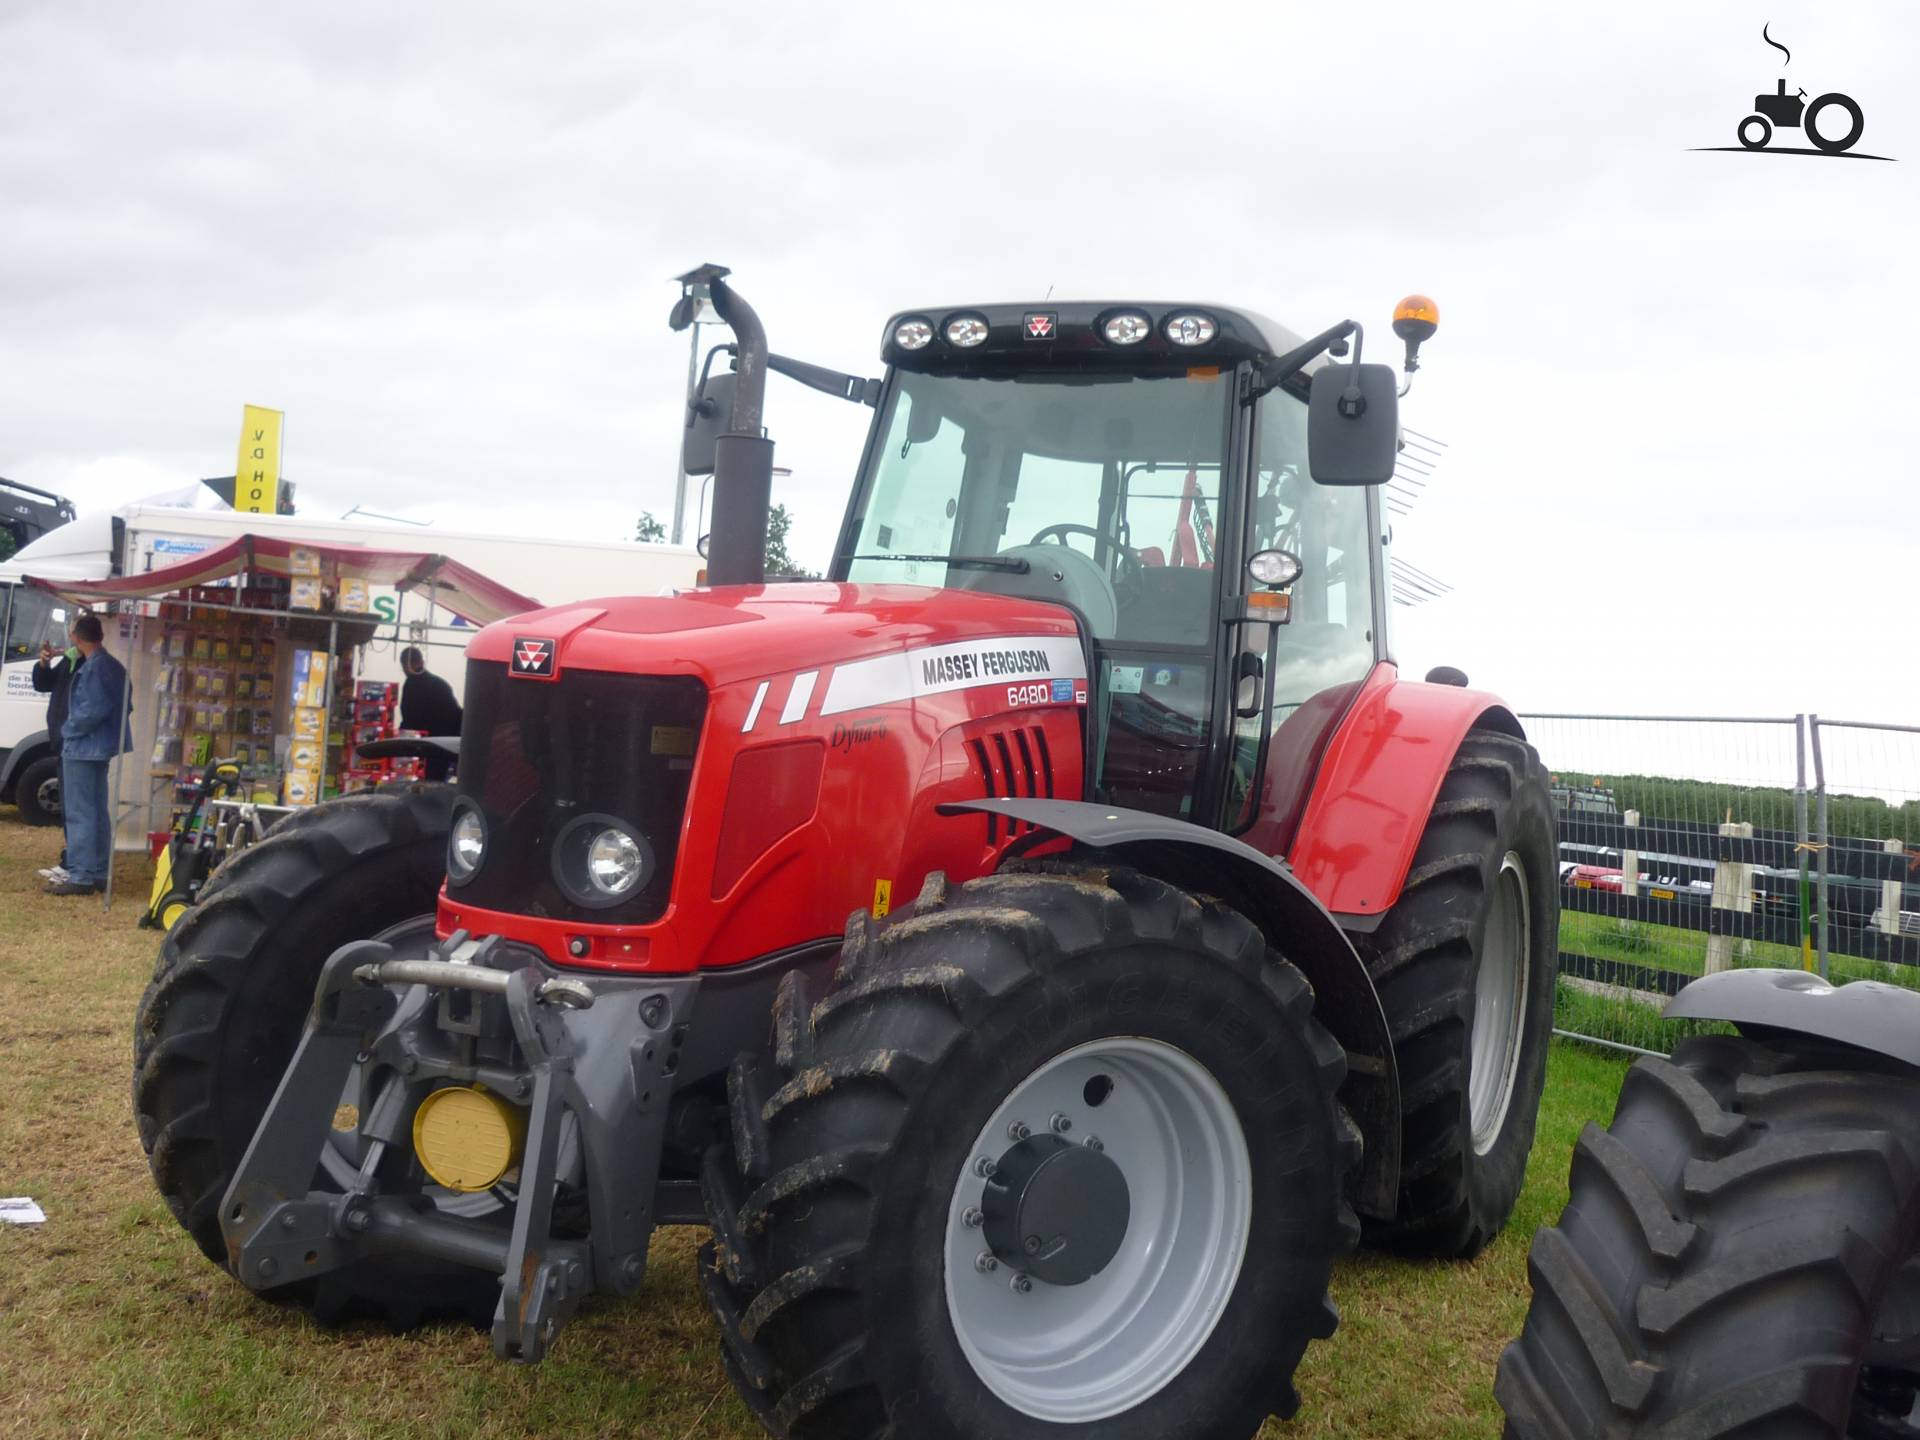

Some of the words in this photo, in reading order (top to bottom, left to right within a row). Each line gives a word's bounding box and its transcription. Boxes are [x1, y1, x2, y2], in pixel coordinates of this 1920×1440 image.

[922, 652, 978, 686] MASSEY
[981, 650, 1050, 676] FERGUSON
[1007, 684, 1048, 706] 6480
